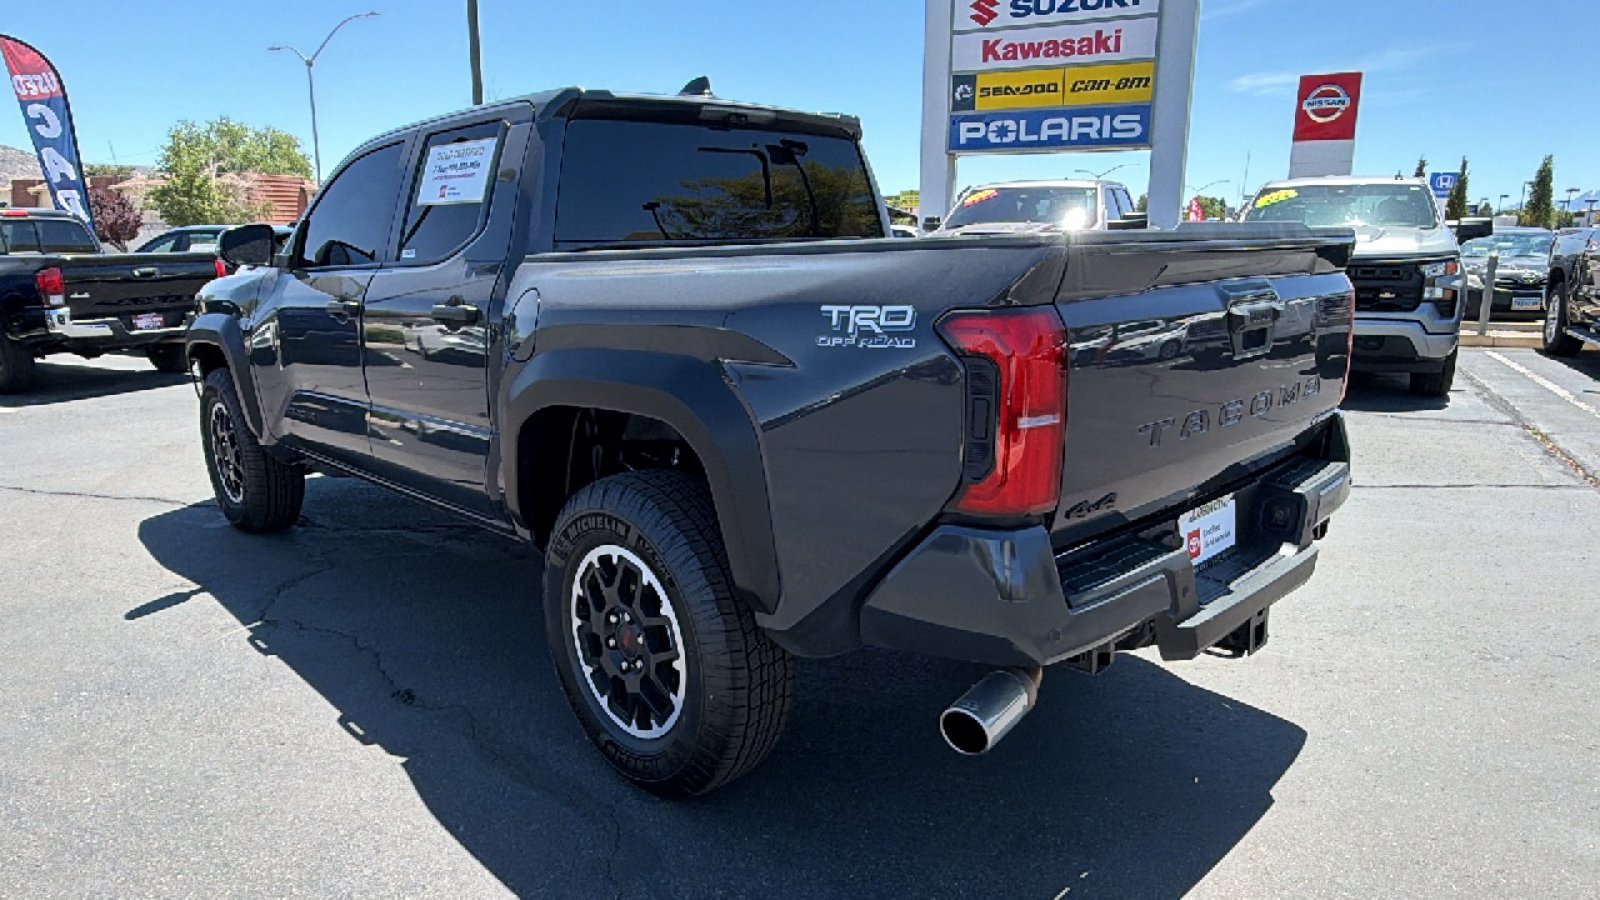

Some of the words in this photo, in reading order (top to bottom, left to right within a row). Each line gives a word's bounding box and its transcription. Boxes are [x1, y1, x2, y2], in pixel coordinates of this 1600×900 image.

[981, 28, 1122, 63] Kawasaki
[1307, 99, 1346, 107] NISSAN
[959, 114, 1143, 144] POLARIS
[820, 305, 916, 337] TRD
[816, 336, 855, 347] OFF
[1138, 374, 1321, 448] TACOMA
[568, 515, 628, 541] MICHELIN
